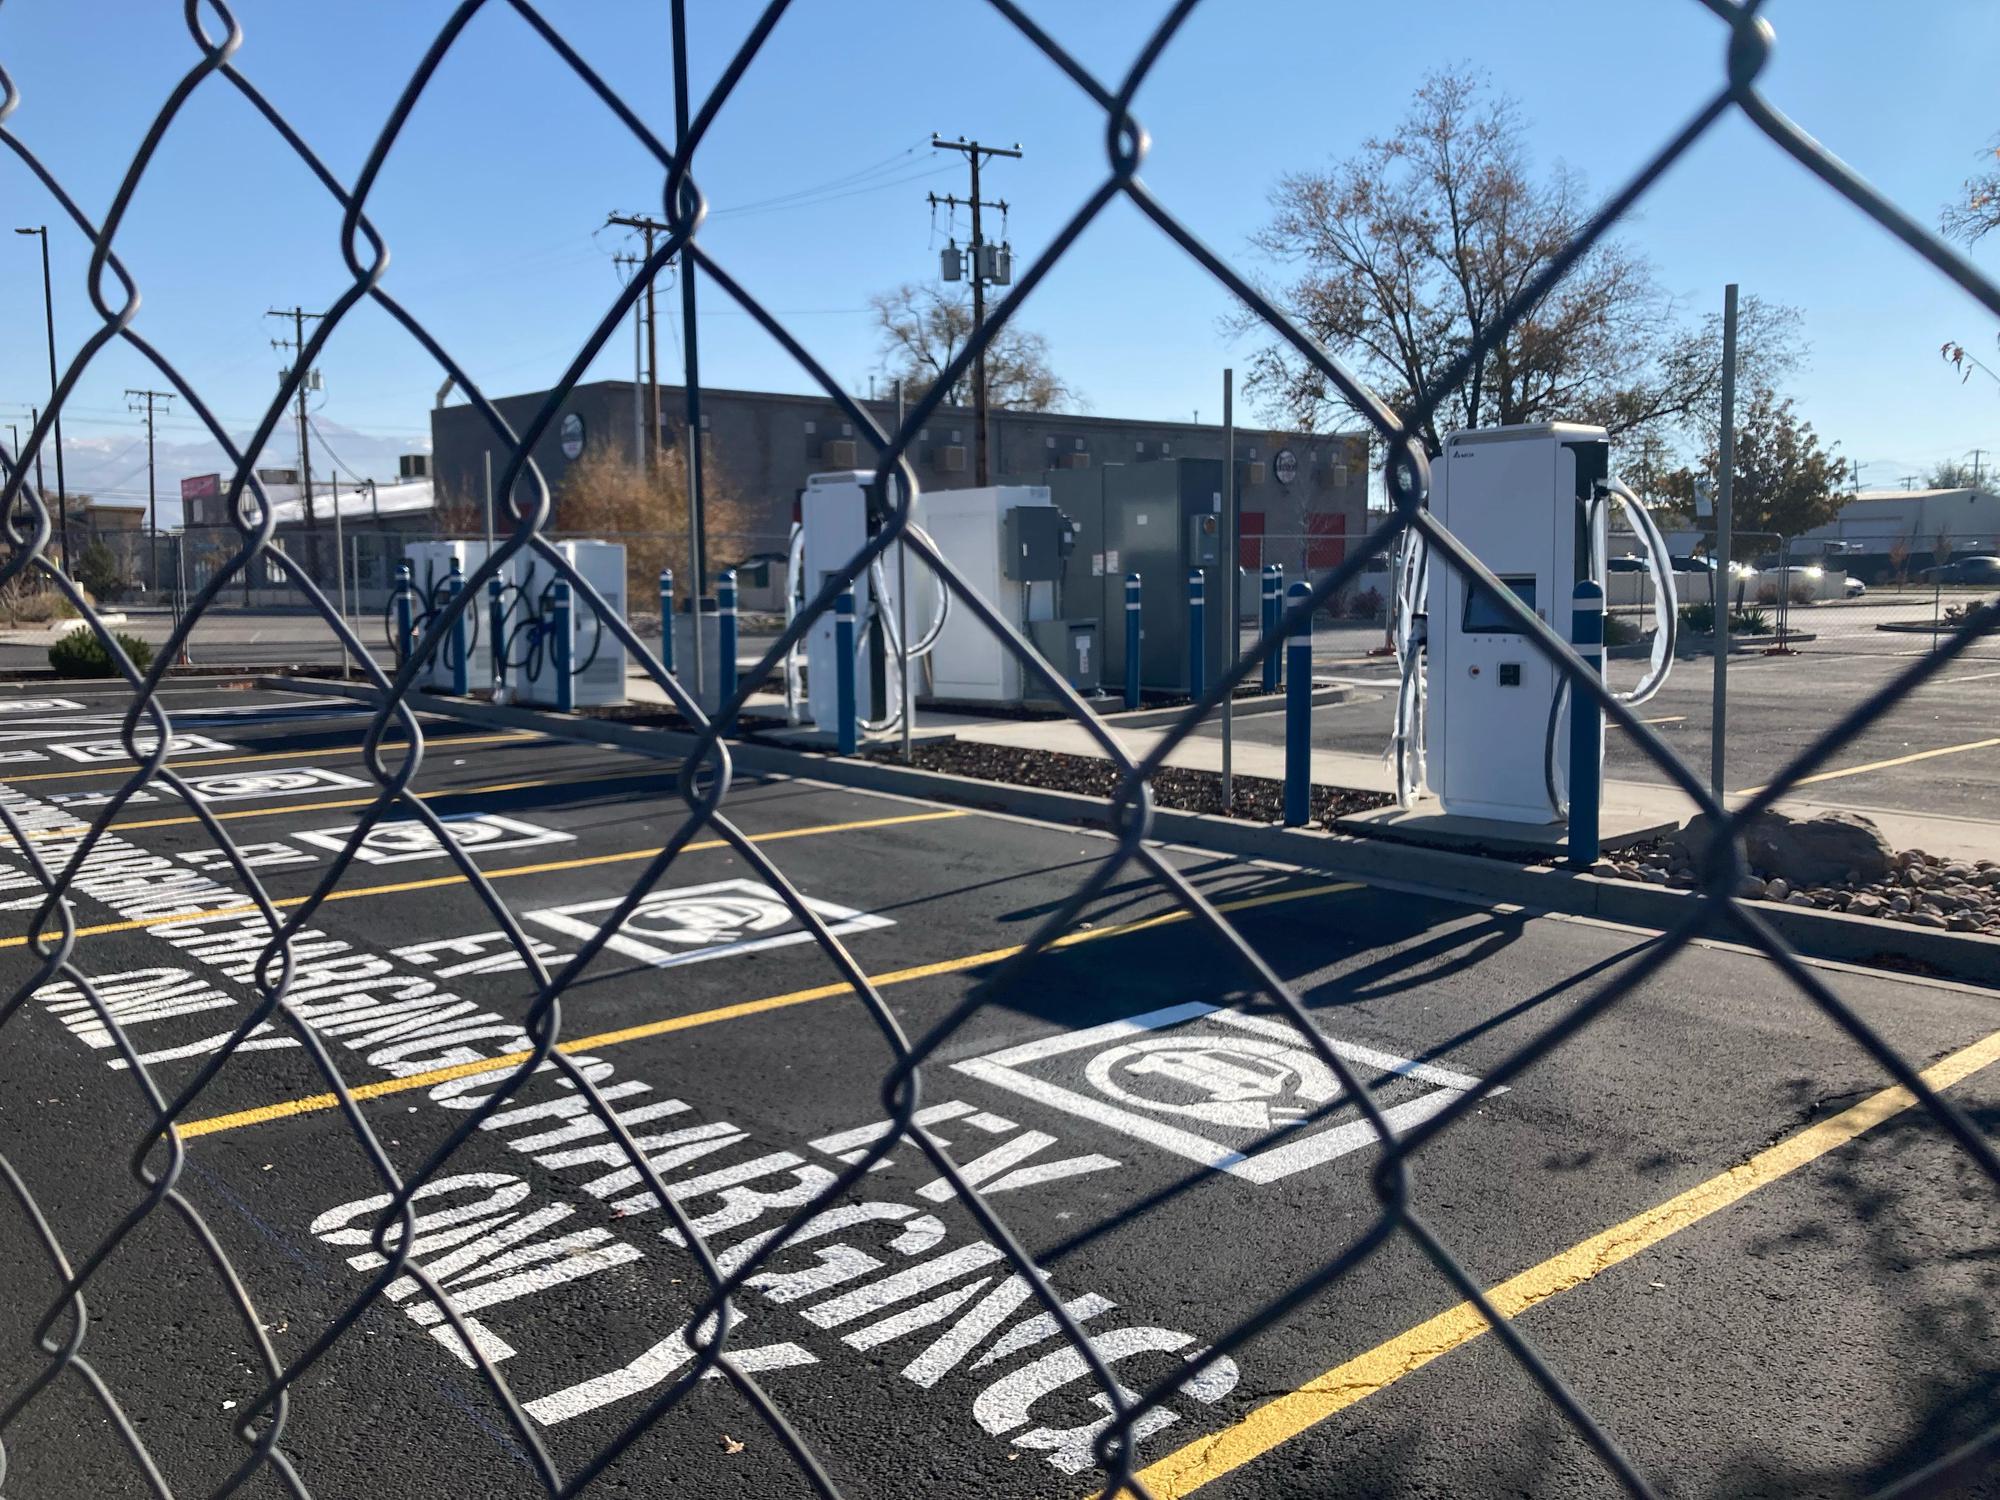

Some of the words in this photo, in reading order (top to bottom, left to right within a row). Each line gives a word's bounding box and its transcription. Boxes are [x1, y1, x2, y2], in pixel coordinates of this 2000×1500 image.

[175, 842, 320, 870] EV
[146, 910, 540, 1078] CHARGING
[389, 930, 577, 978] EV
[32, 967, 302, 1070] ONLY
[807, 1100, 1122, 1202] EV
[310, 1172, 819, 1426] ONLY
[429, 1056, 1239, 1475] CHARGING
